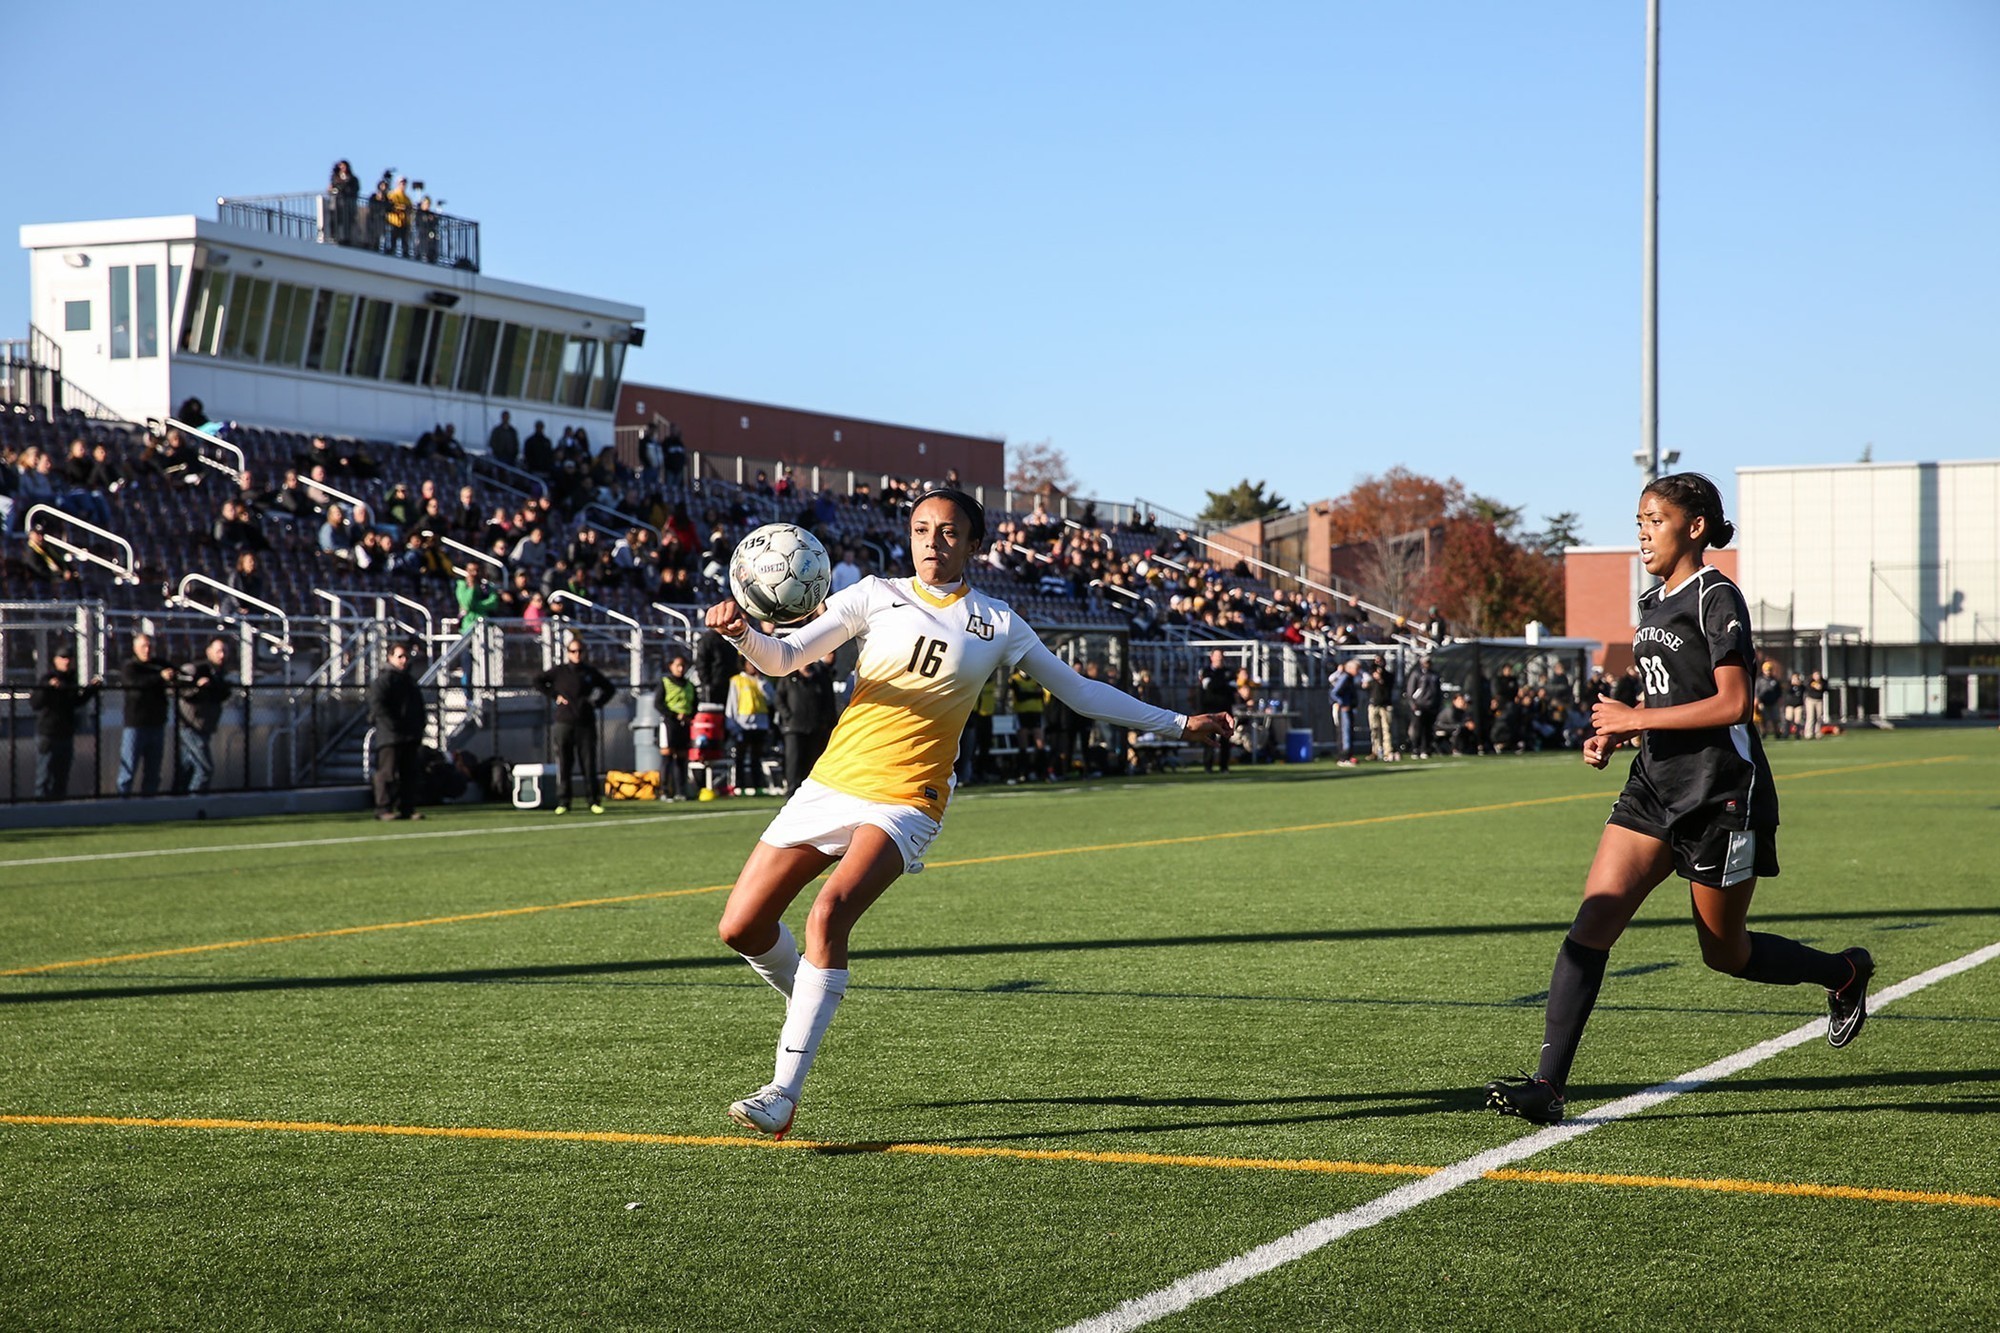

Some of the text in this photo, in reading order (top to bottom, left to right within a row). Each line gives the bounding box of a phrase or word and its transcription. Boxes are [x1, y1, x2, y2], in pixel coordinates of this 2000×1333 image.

[966, 614, 994, 642] AU
[907, 635, 948, 679] 16
[1639, 655, 1670, 695] 20
